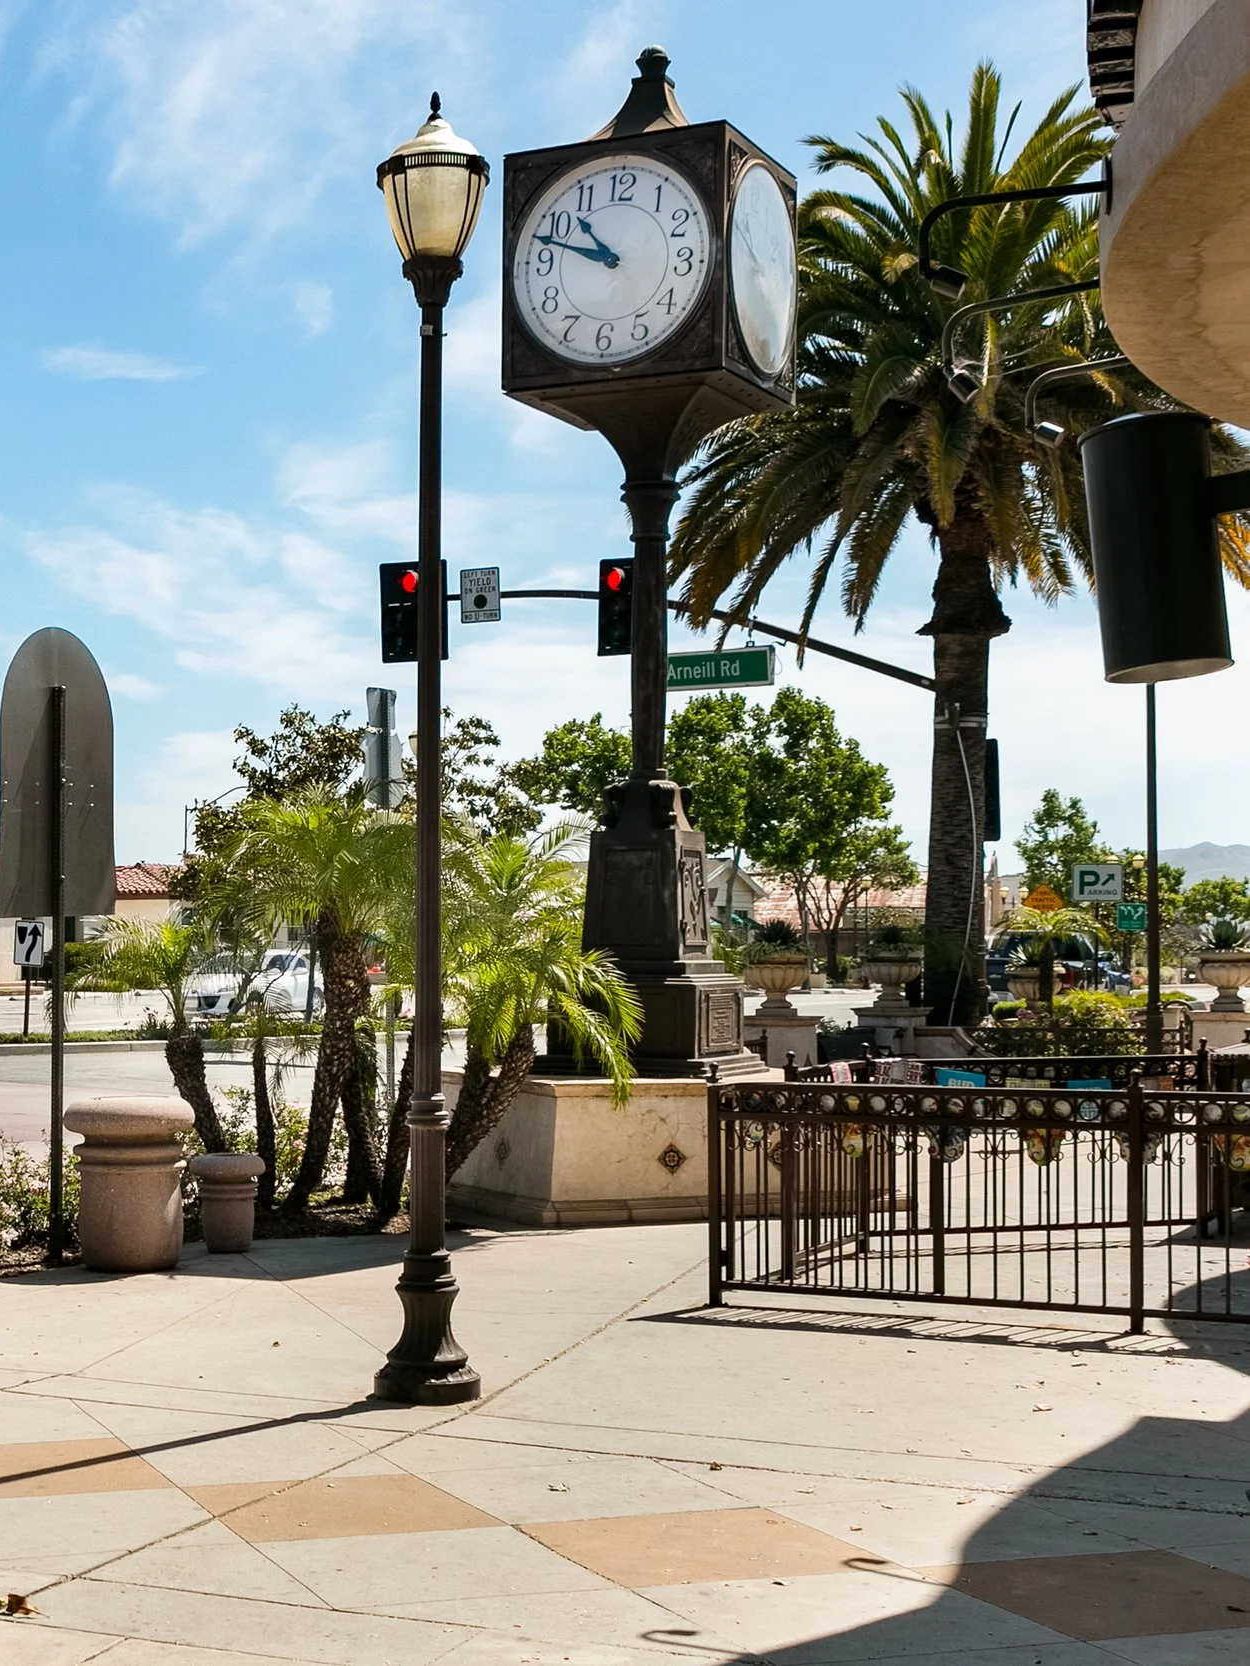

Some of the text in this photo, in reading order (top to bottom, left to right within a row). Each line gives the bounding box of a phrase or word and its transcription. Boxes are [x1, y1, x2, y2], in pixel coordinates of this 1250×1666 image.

[575, 183, 594, 212] 11
[609, 172, 637, 202] 12
[654, 184, 663, 213] 1
[549, 210, 571, 239] 10
[670, 209, 690, 238] 2
[536, 248, 554, 276] 9
[674, 247, 693, 276] 3
[541, 286, 559, 314] 8
[656, 287, 677, 315] 4
[561, 315, 581, 343] 7
[596, 323, 614, 350] 6
[630, 311, 650, 341] 5
[463, 571, 478, 579] LEFT
[469, 577, 491, 587] YIELD
[475, 585, 496, 593] GREEN
[667, 660, 740, 681] Arneill Rd
